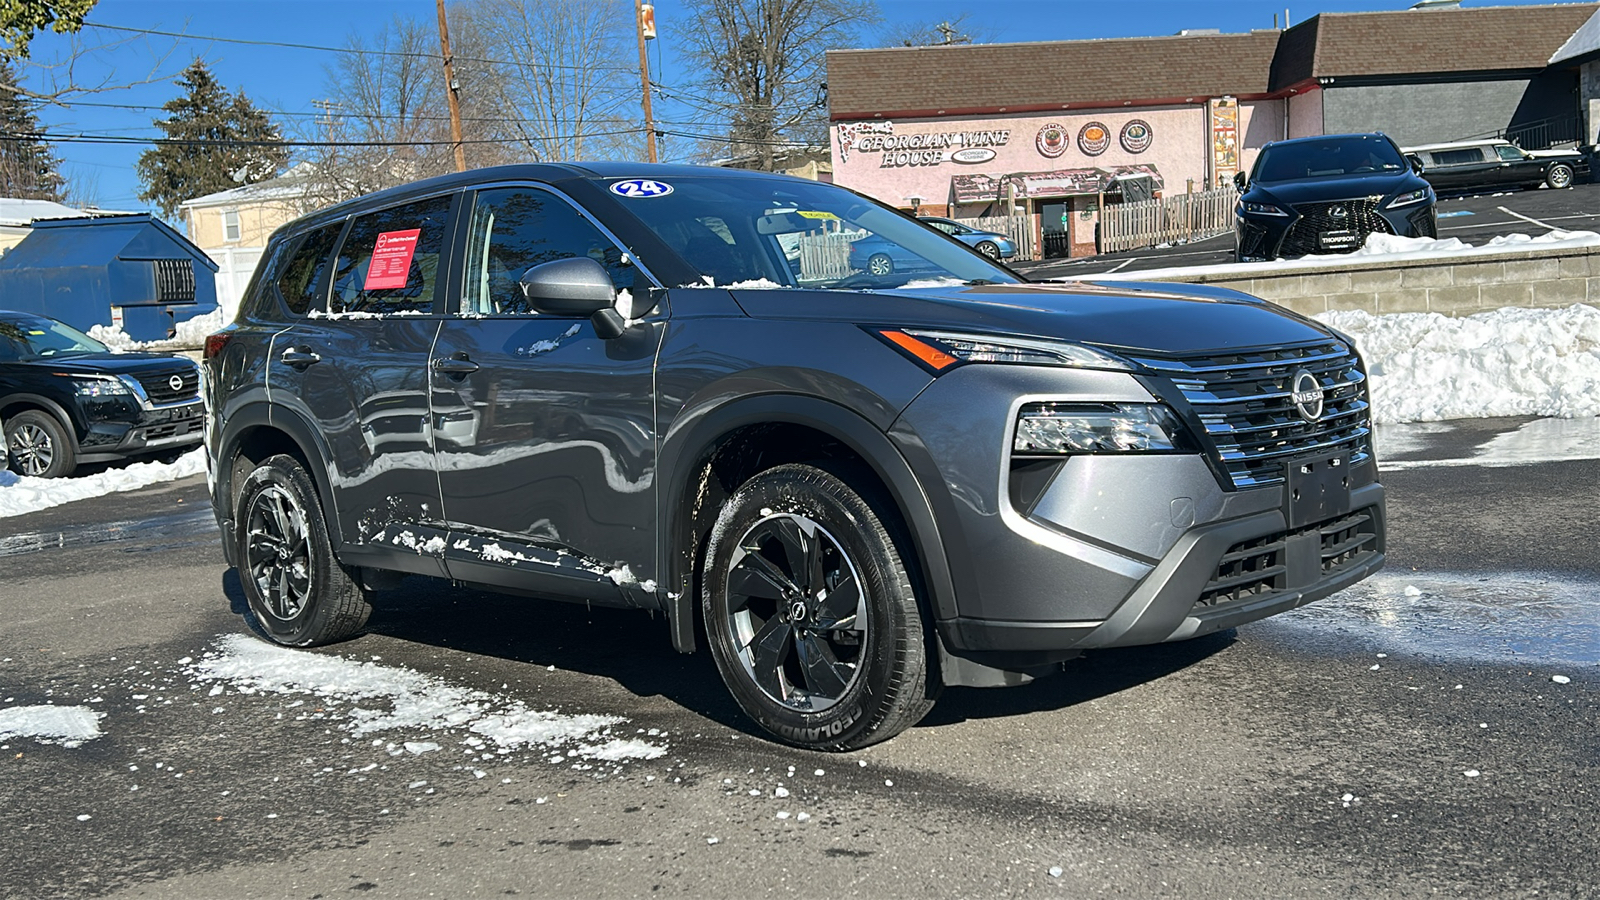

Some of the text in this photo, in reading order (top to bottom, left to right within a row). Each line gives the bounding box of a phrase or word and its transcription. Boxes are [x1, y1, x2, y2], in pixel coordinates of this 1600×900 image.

[859, 130, 1010, 151] GEORGIAN WINE
[881, 150, 942, 168] HOUSE
[620, 181, 662, 196] 24
